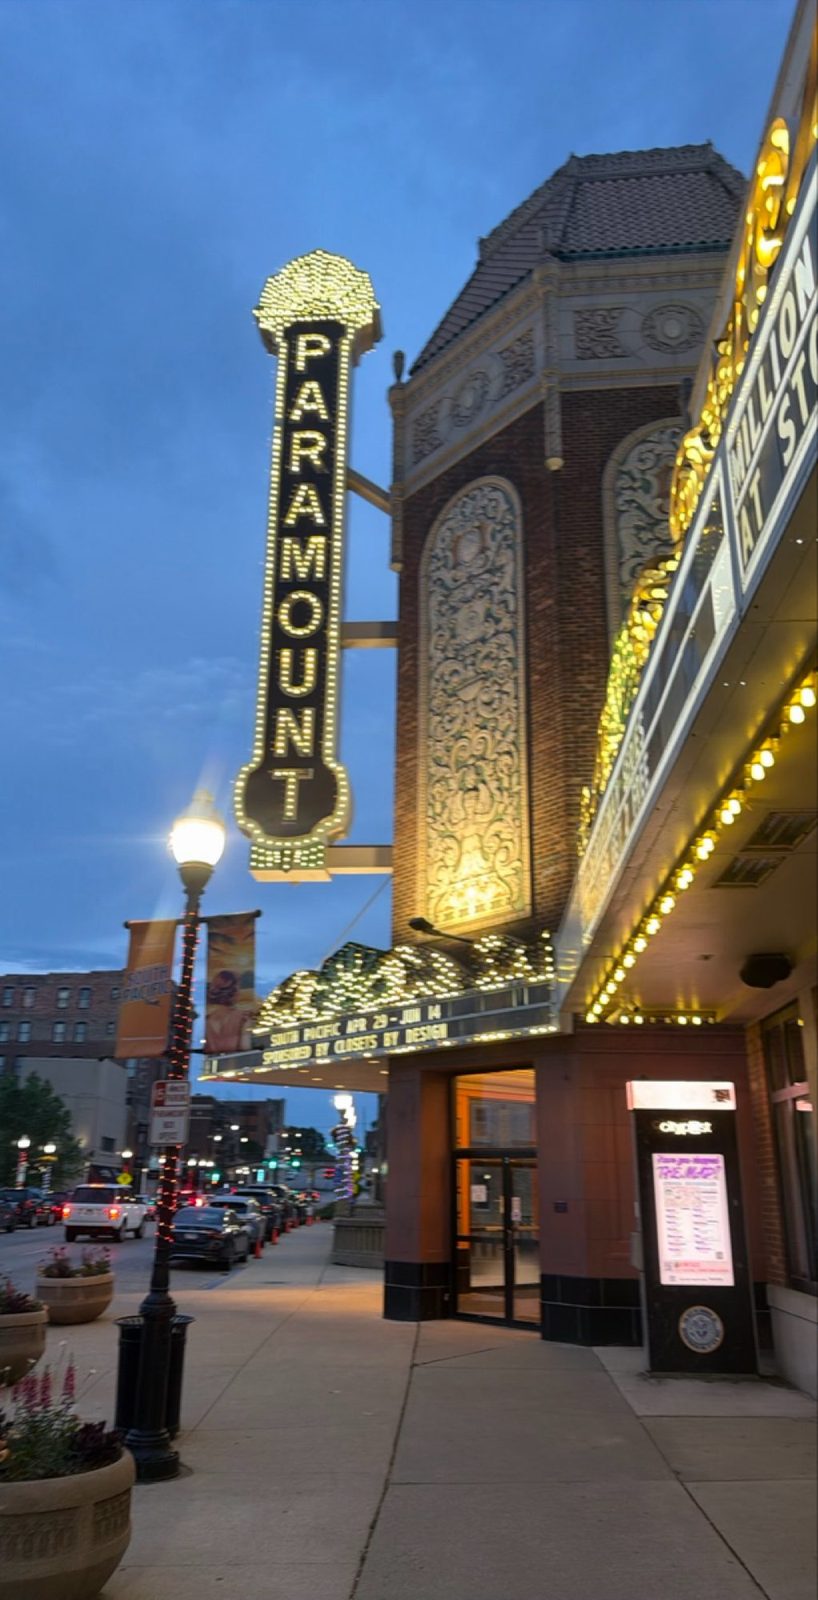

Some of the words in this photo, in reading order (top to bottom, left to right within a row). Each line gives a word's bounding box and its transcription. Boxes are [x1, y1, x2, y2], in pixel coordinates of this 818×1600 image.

[732, 234, 816, 498] MILLION
[740, 467, 763, 566] AT
[272, 332, 332, 823] PARAMOUNT
[262, 1045, 312, 1065] SPONSORED
[315, 1041, 330, 1057] BY
[334, 1034, 378, 1054] CLOSETS
[383, 1031, 399, 1048] BY
[405, 1023, 448, 1044] DESIGN
[270, 1030, 300, 1047] SOUTH
[303, 1022, 341, 1042] PACIFIC
[346, 1017, 367, 1034] APR
[428, 1004, 441, 1020] 14
